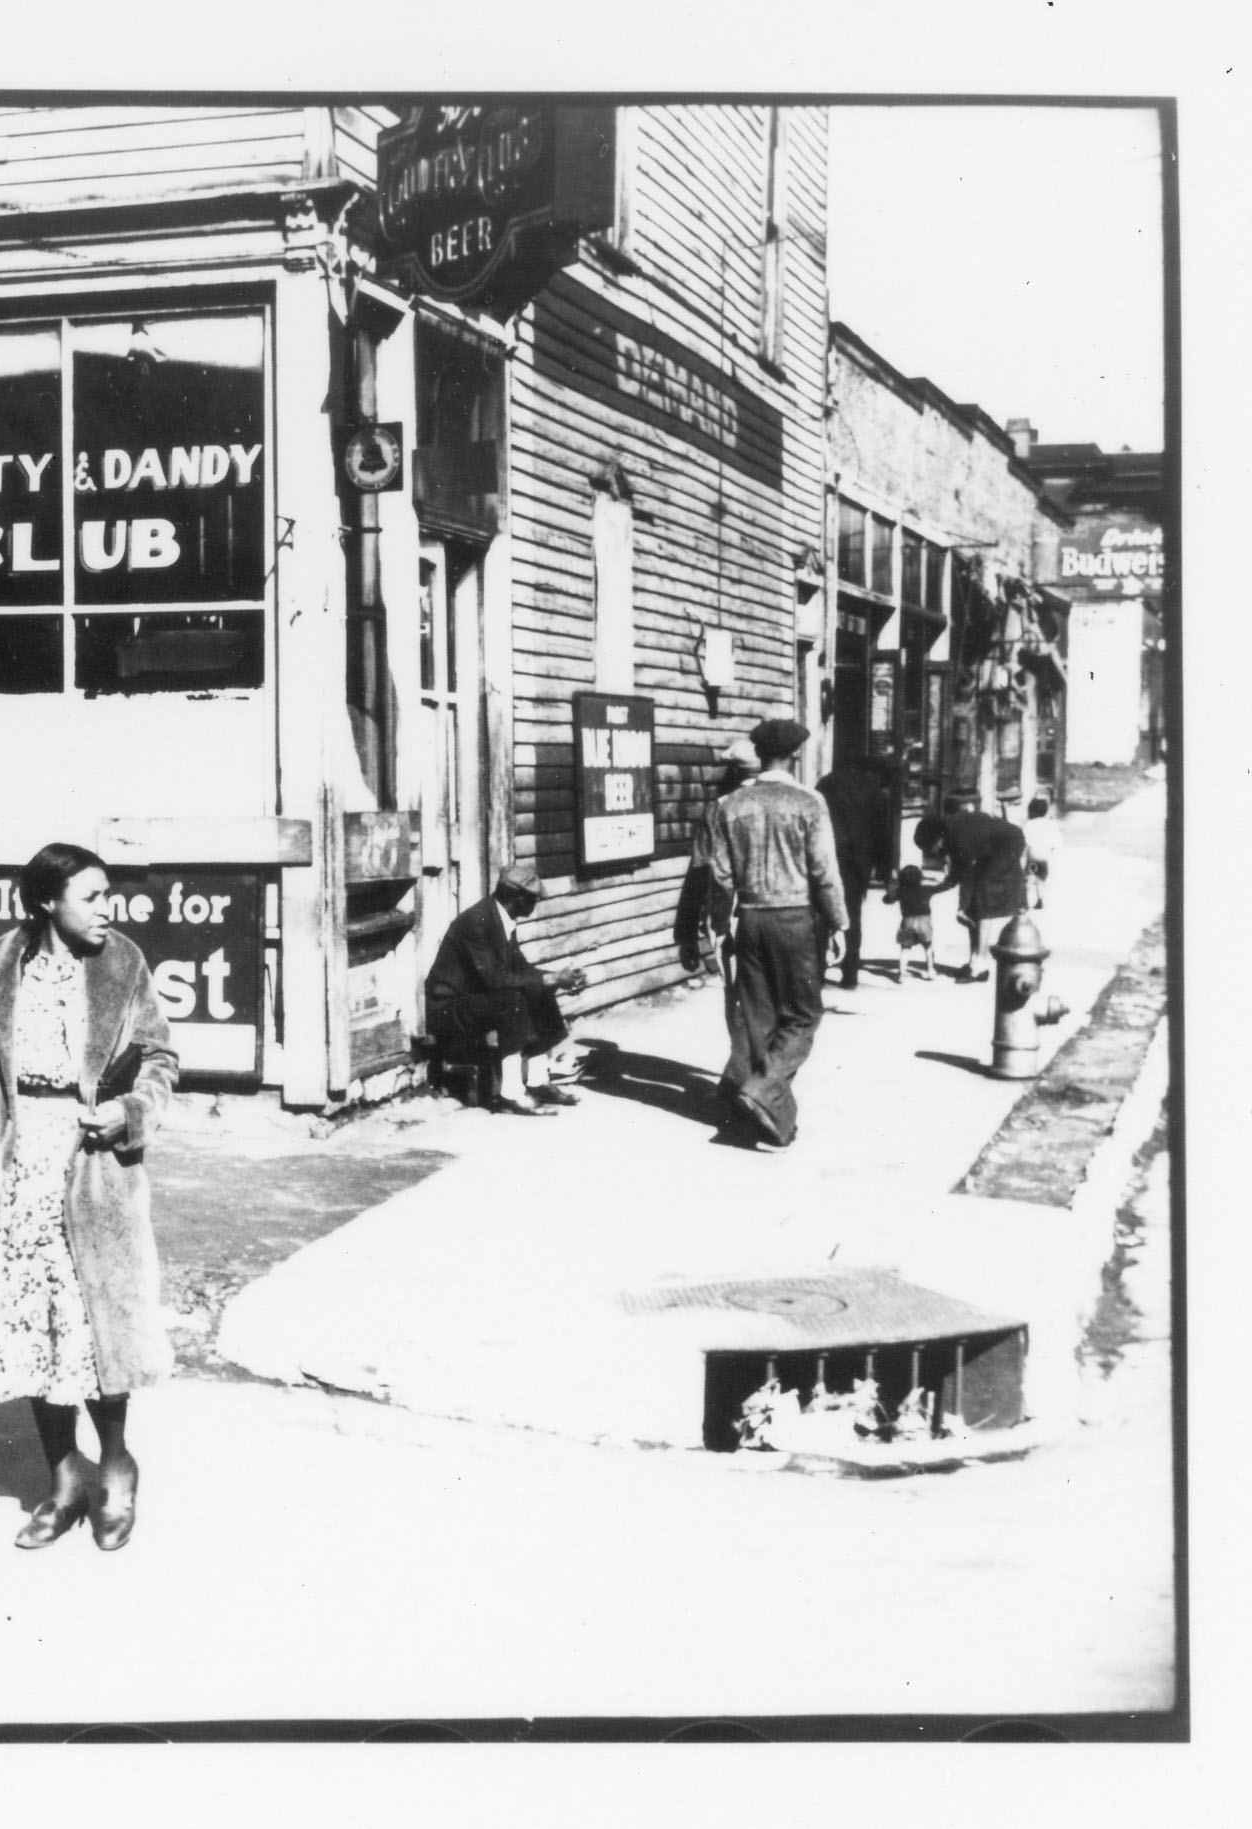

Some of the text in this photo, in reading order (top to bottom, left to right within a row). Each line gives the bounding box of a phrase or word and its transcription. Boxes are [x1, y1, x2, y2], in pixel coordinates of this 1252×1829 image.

[430, 217, 493, 267] BEER
[75, 451, 98, 492] &
[103, 444, 263, 490] DANDY
[168, 881, 232, 924] for
